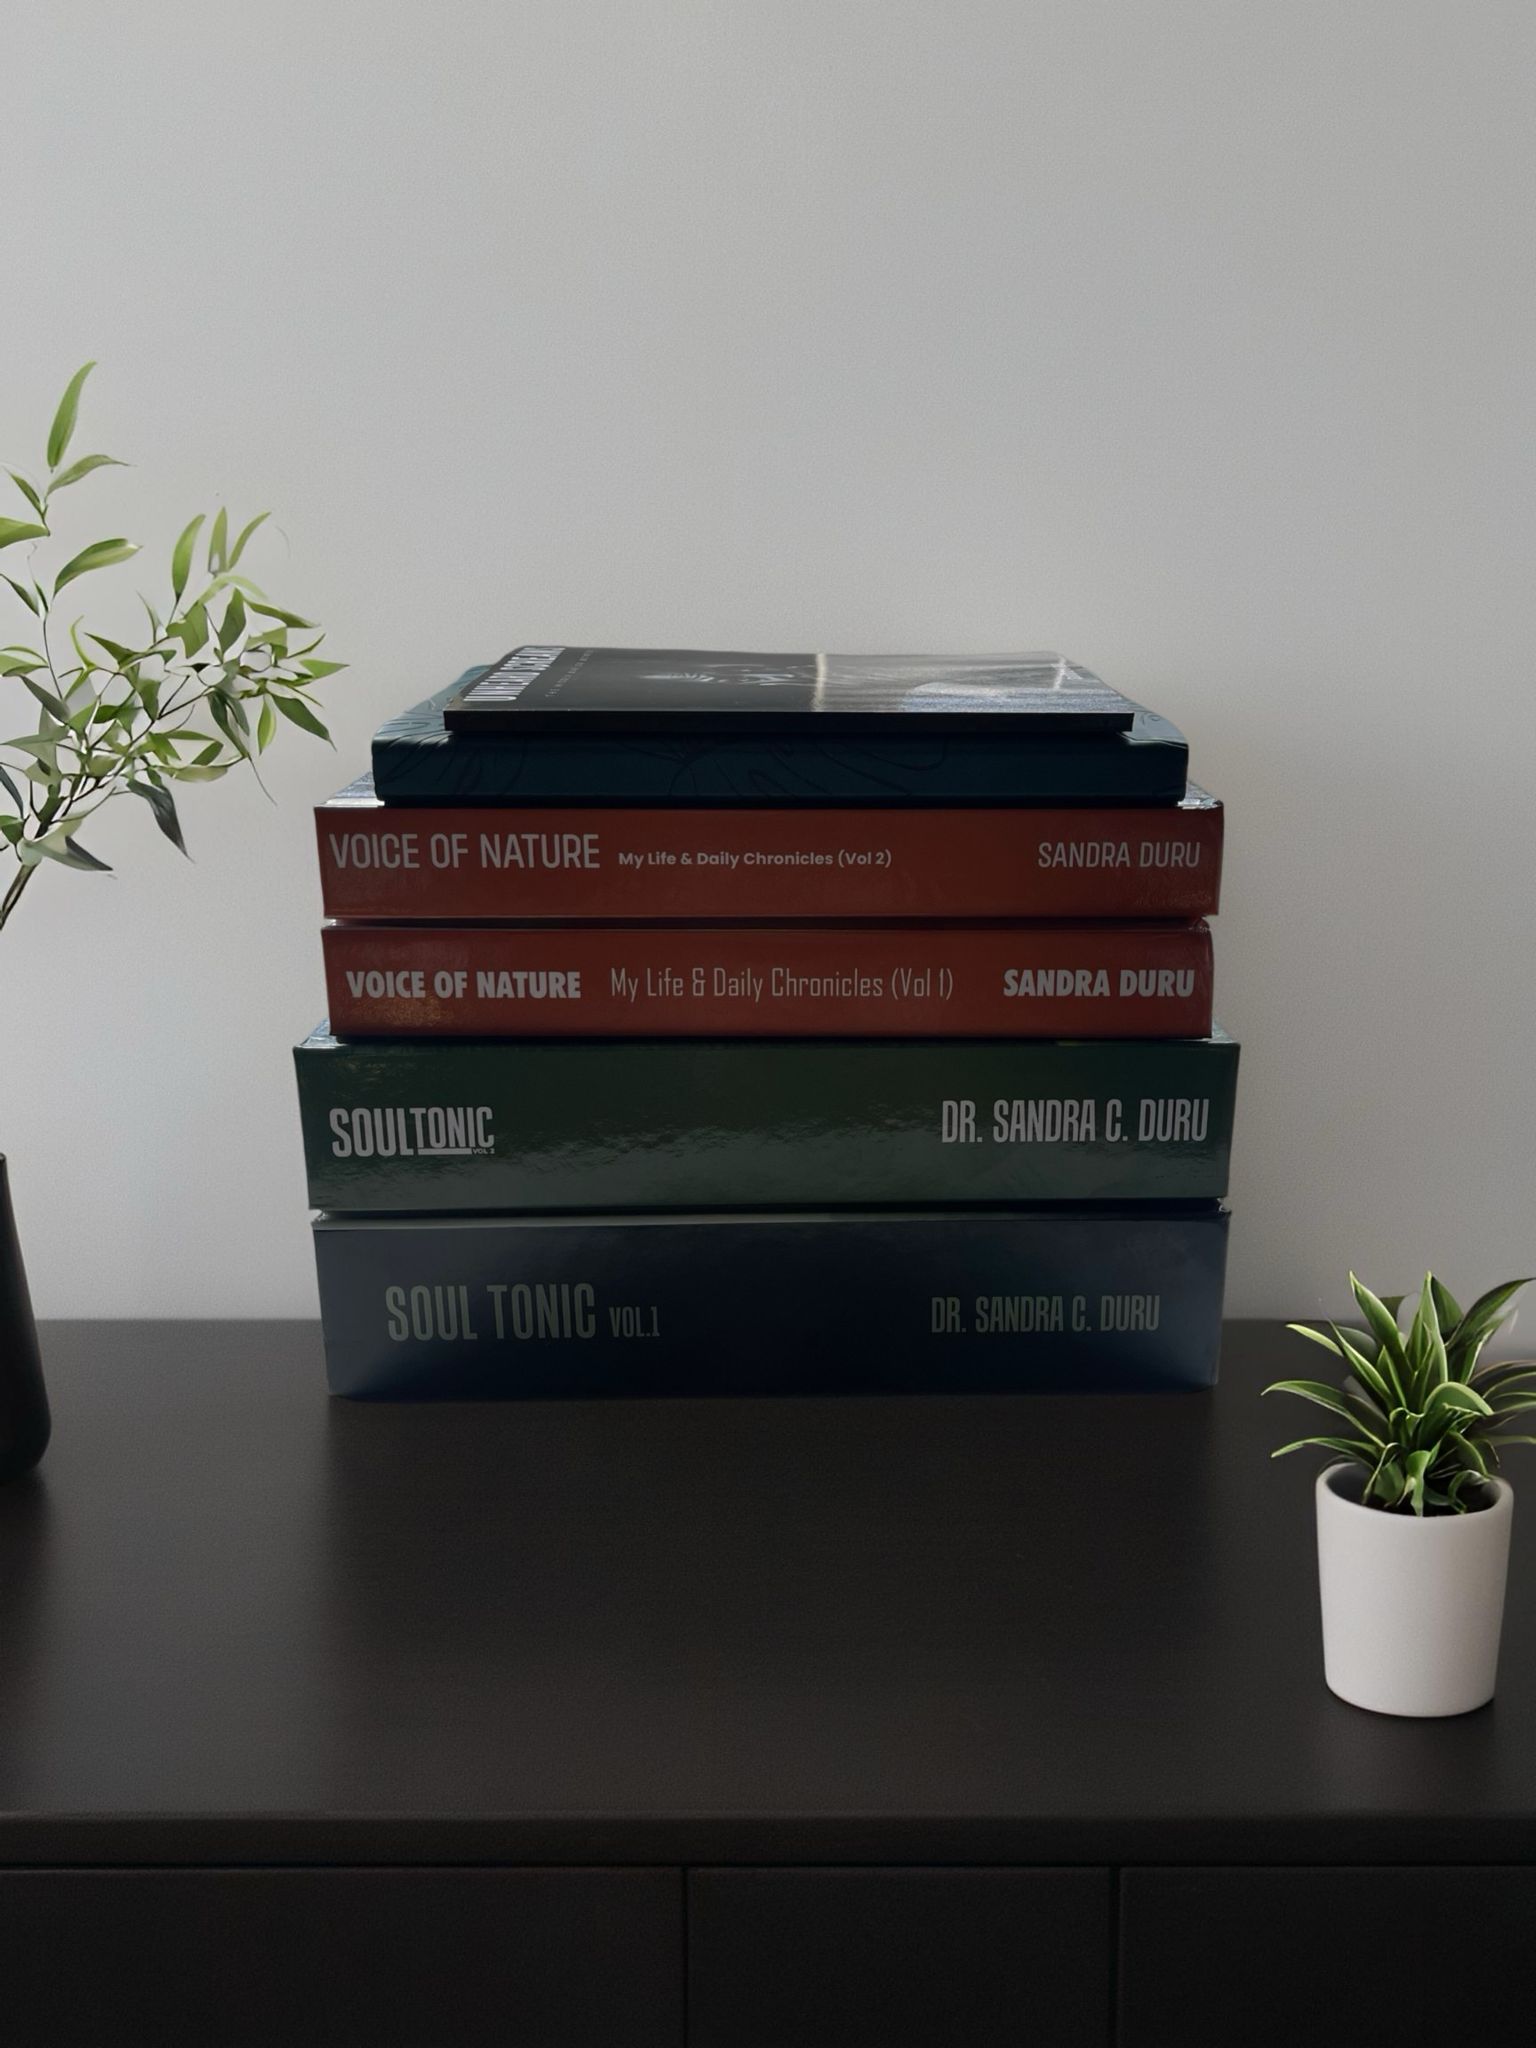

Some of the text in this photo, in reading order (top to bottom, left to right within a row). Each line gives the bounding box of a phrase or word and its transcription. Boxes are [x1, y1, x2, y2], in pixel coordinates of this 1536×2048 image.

[329, 833, 600, 869] VOICE OF NATURE
[618, 849, 892, 869] My Life & Daily Chronicles (Vol 2)
[1037, 841, 1201, 868] SANDRA DURU
[345, 970, 582, 999] VOICE OF NATURE
[610, 967, 954, 1003] My Life & Daily Chronicles (Vol 1)
[1003, 969, 1195, 998] SANDRA DURU
[941, 1098, 1210, 1143] DR. SANDRA C. DURU
[385, 1282, 660, 1341] SOUL TONIC VOL.1
[930, 1295, 1161, 1333] DR. SANDRA C. DURU
